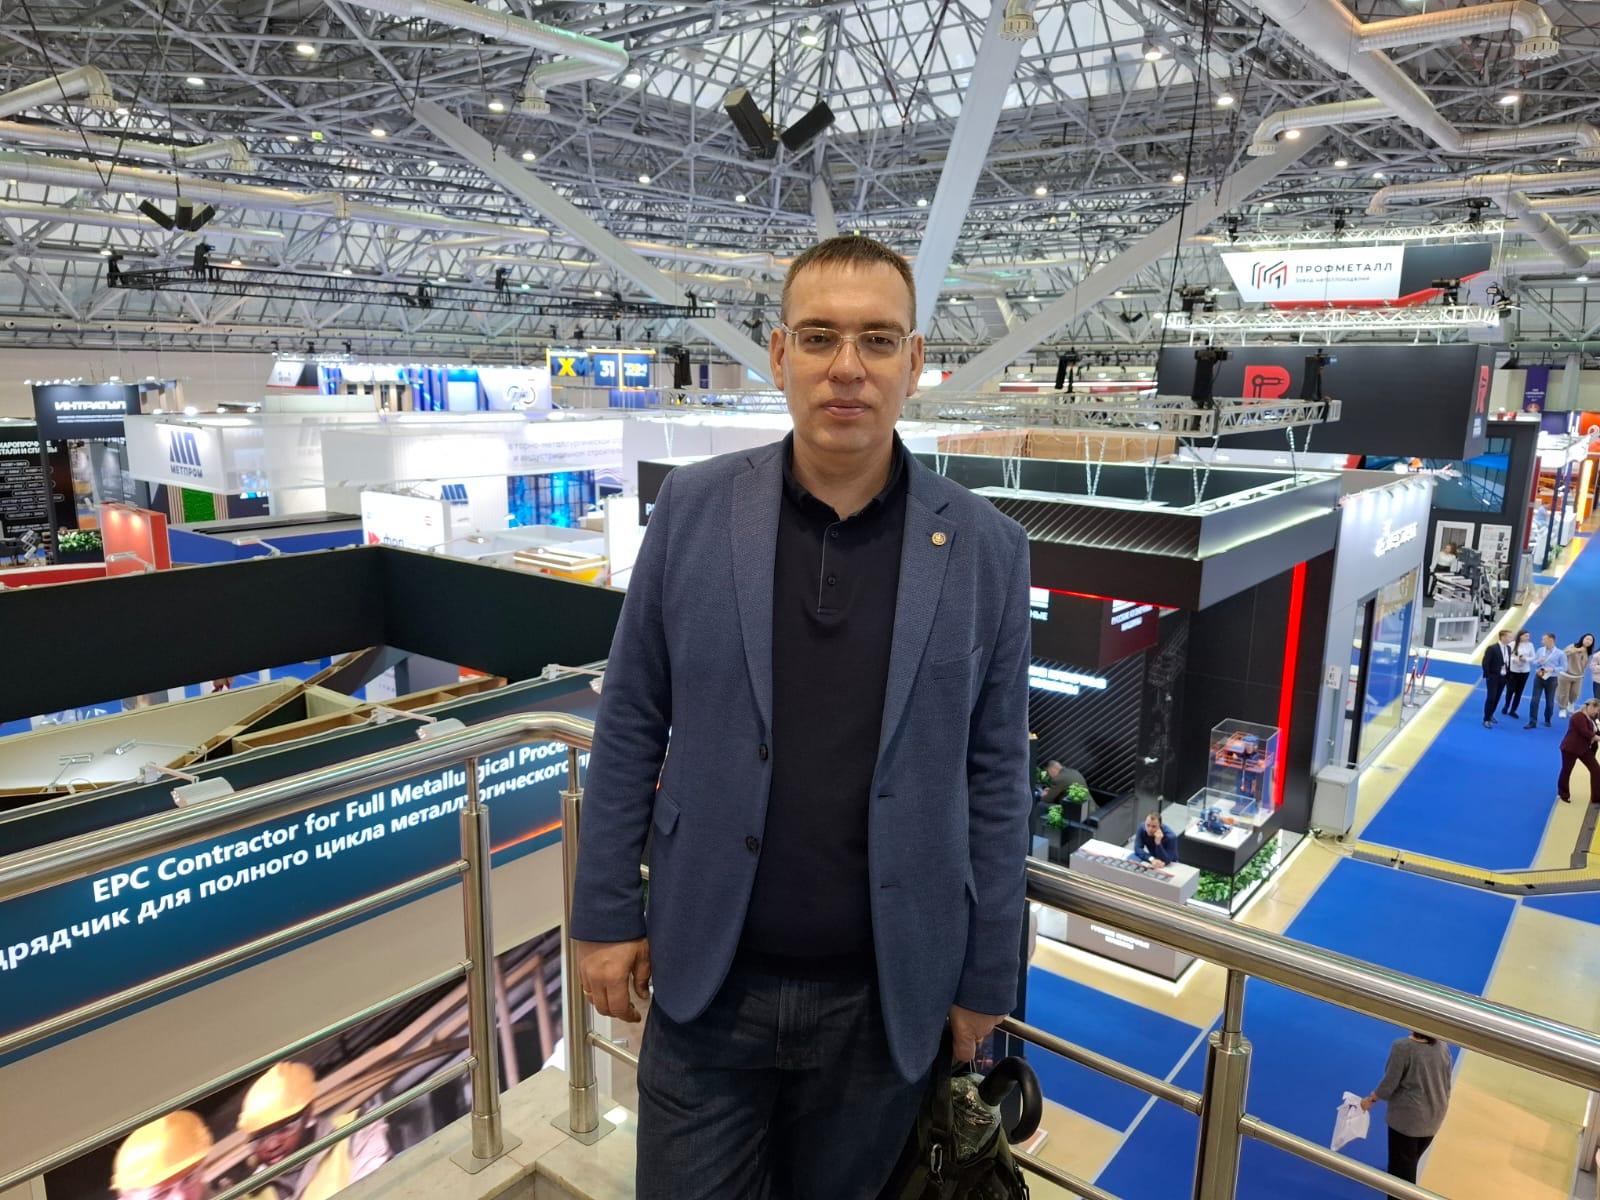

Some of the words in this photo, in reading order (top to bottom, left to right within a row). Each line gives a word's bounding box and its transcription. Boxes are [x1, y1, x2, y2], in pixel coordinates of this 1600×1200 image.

[1296, 262, 1393, 274] ПРОФМЕТАЛЛ
[170, 465, 203, 478] МЕТПРОМ
[92, 866, 151, 903] EPC
[156, 825, 299, 884] Contractor
[304, 812, 341, 835] for
[346, 791, 385, 822] Full
[391, 750, 515, 806] Metallugical
[519, 741, 569, 765] Proce
[136, 887, 192, 924] для
[199, 849, 309, 900] полного
[315, 823, 385, 860] цикла
[391, 760, 569, 833] металлгического
